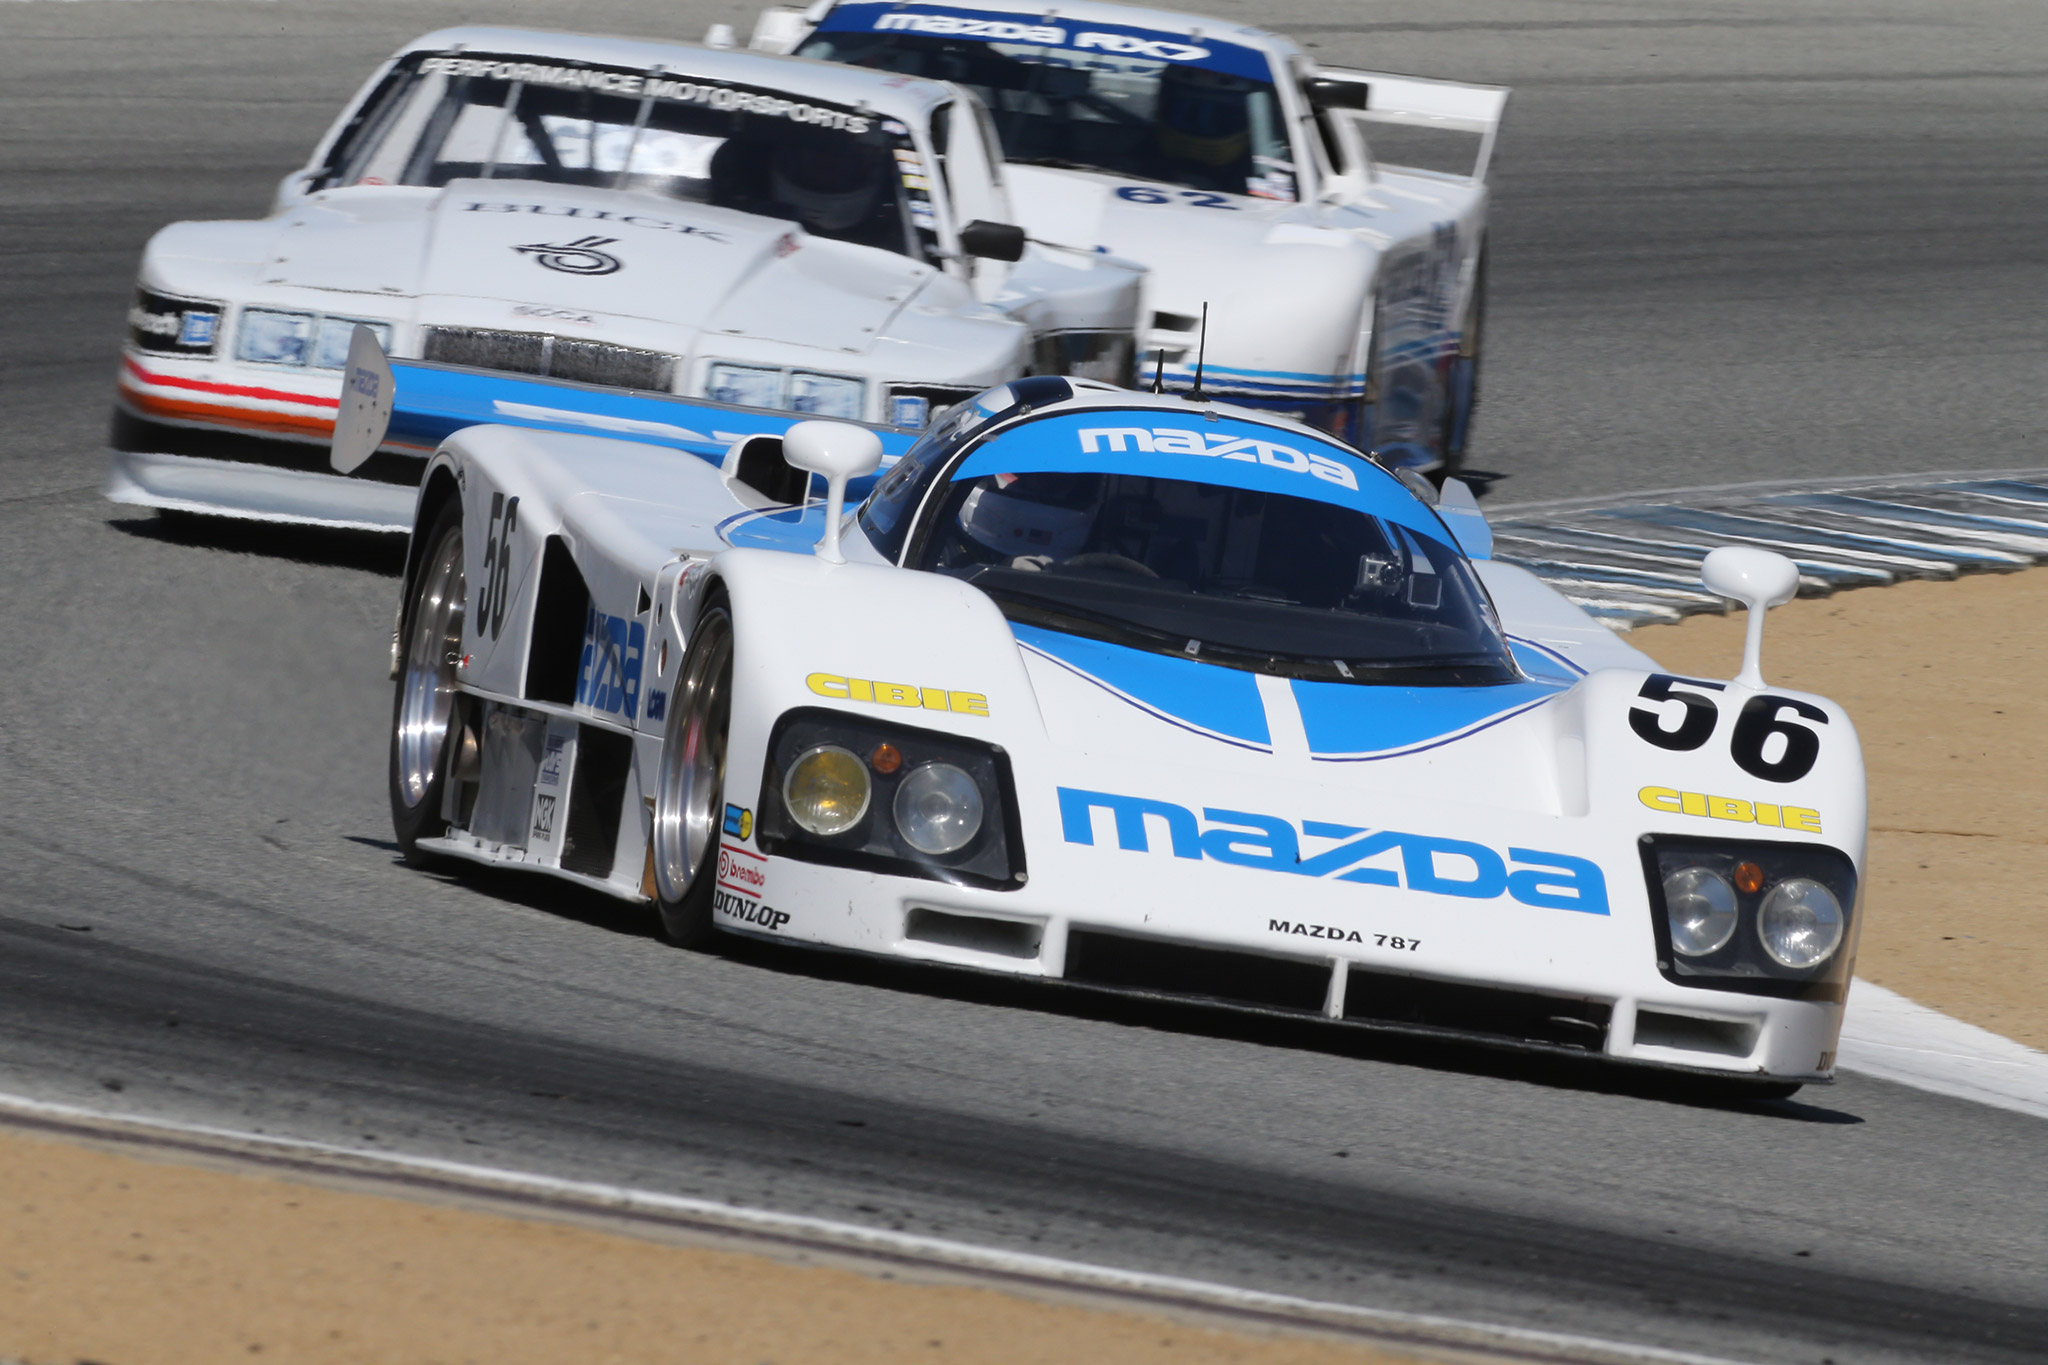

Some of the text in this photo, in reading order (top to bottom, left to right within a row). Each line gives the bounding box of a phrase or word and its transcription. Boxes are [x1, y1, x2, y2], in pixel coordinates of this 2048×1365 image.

[417, 57, 870, 134] PERFORMANCE MOTORSPORTS
[1113, 186, 1239, 210] 62
[463, 203, 735, 245] BUICK
[1079, 427, 1359, 490] mazda
[477, 491, 520, 642] 56
[806, 672, 990, 717] CIBIE
[1628, 673, 1829, 783] 56
[535, 795, 556, 832] NGK
[1638, 785, 1823, 834] CIBIE
[730, 858, 765, 886] brembo
[1056, 786, 1611, 916] mazda
[714, 889, 791, 931] DUNLOP
[1268, 918, 1422, 952] MAZDA 787
